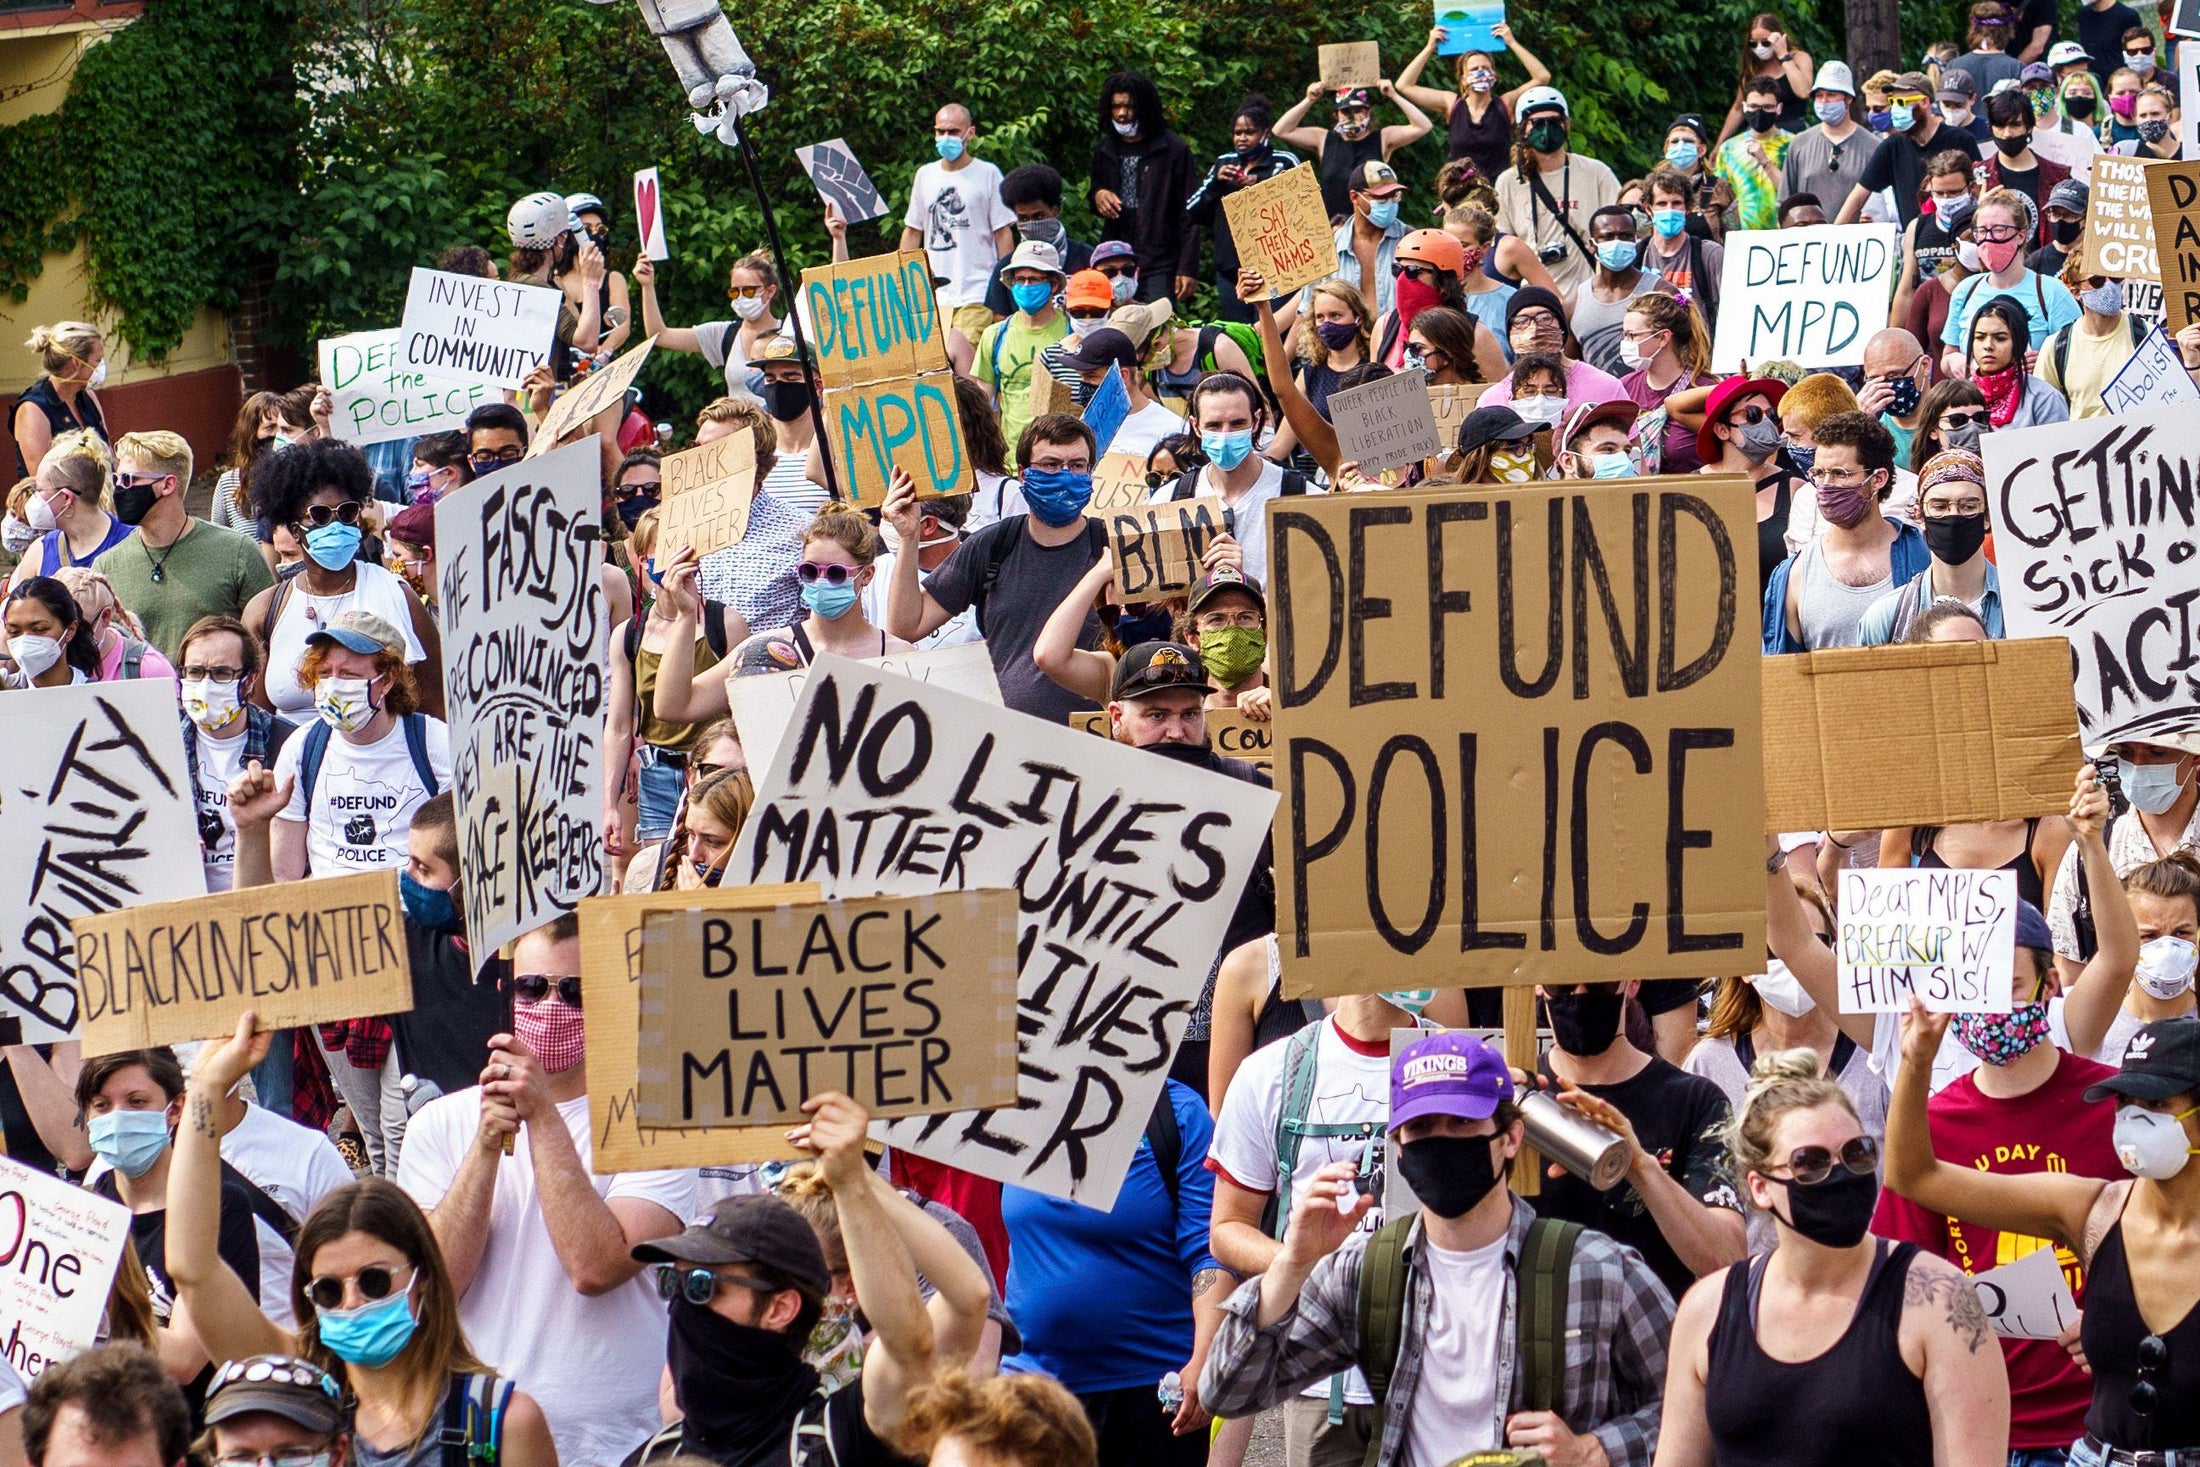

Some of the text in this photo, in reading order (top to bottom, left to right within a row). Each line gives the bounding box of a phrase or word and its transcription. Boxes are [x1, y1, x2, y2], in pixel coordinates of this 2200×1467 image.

[2095, 201, 2124, 218] THE
[2097, 182, 2147, 201] THEIR
[1255, 228, 1296, 256] THEIR
[1260, 201, 1287, 234] SAY
[2094, 220, 2141, 241] WILL
[1272, 238, 1315, 276] NAMES
[1747, 238, 1886, 287] DEFUND
[429, 276, 527, 318] INVEST
[809, 260, 935, 361] DEFUND
[454, 315, 476, 337] IN
[1750, 301, 1860, 357] MPD
[408, 332, 544, 379] COMMUNITY
[2114, 337, 2171, 414] Abolish
[382, 370, 427, 393] the
[1333, 377, 1420, 414] QUEER PEOPLE FOR
[348, 384, 484, 436] POLICE
[1351, 416, 1424, 453] LIBERATION
[1361, 404, 1397, 429] BLACK
[840, 379, 962, 500] MPD
[1385, 446, 1407, 462] PRIDE
[670, 442, 729, 495] BLACK
[667, 481, 727, 530] LIVES
[662, 508, 742, 566] MATTER
[1114, 504, 1217, 595] BLM
[442, 483, 601, 661] THE FASCISTS
[1273, 492, 1736, 708] DEFUND
[467, 624, 601, 722] CONVINCED
[494, 708, 537, 768] ARE
[547, 715, 593, 802] THE
[330, 796, 397, 810] #DEFUND
[789, 674, 1231, 902] NO LIVES
[336, 849, 387, 863] POLICE
[515, 743, 603, 925] KEEPERS
[1289, 721, 1744, 958] POLICE
[751, 802, 1185, 968] MATTER UNTIL
[1848, 872, 2006, 926] Dear MPLS,
[703, 909, 947, 979] BLACK
[729, 979, 941, 1041] LIVES
[1852, 966, 1990, 1009] HIM SIS!
[682, 1038, 953, 1120] MATTER
[1403, 1054, 1467, 1080] VIKINGS
[1995, 1144, 2040, 1164] DAY
